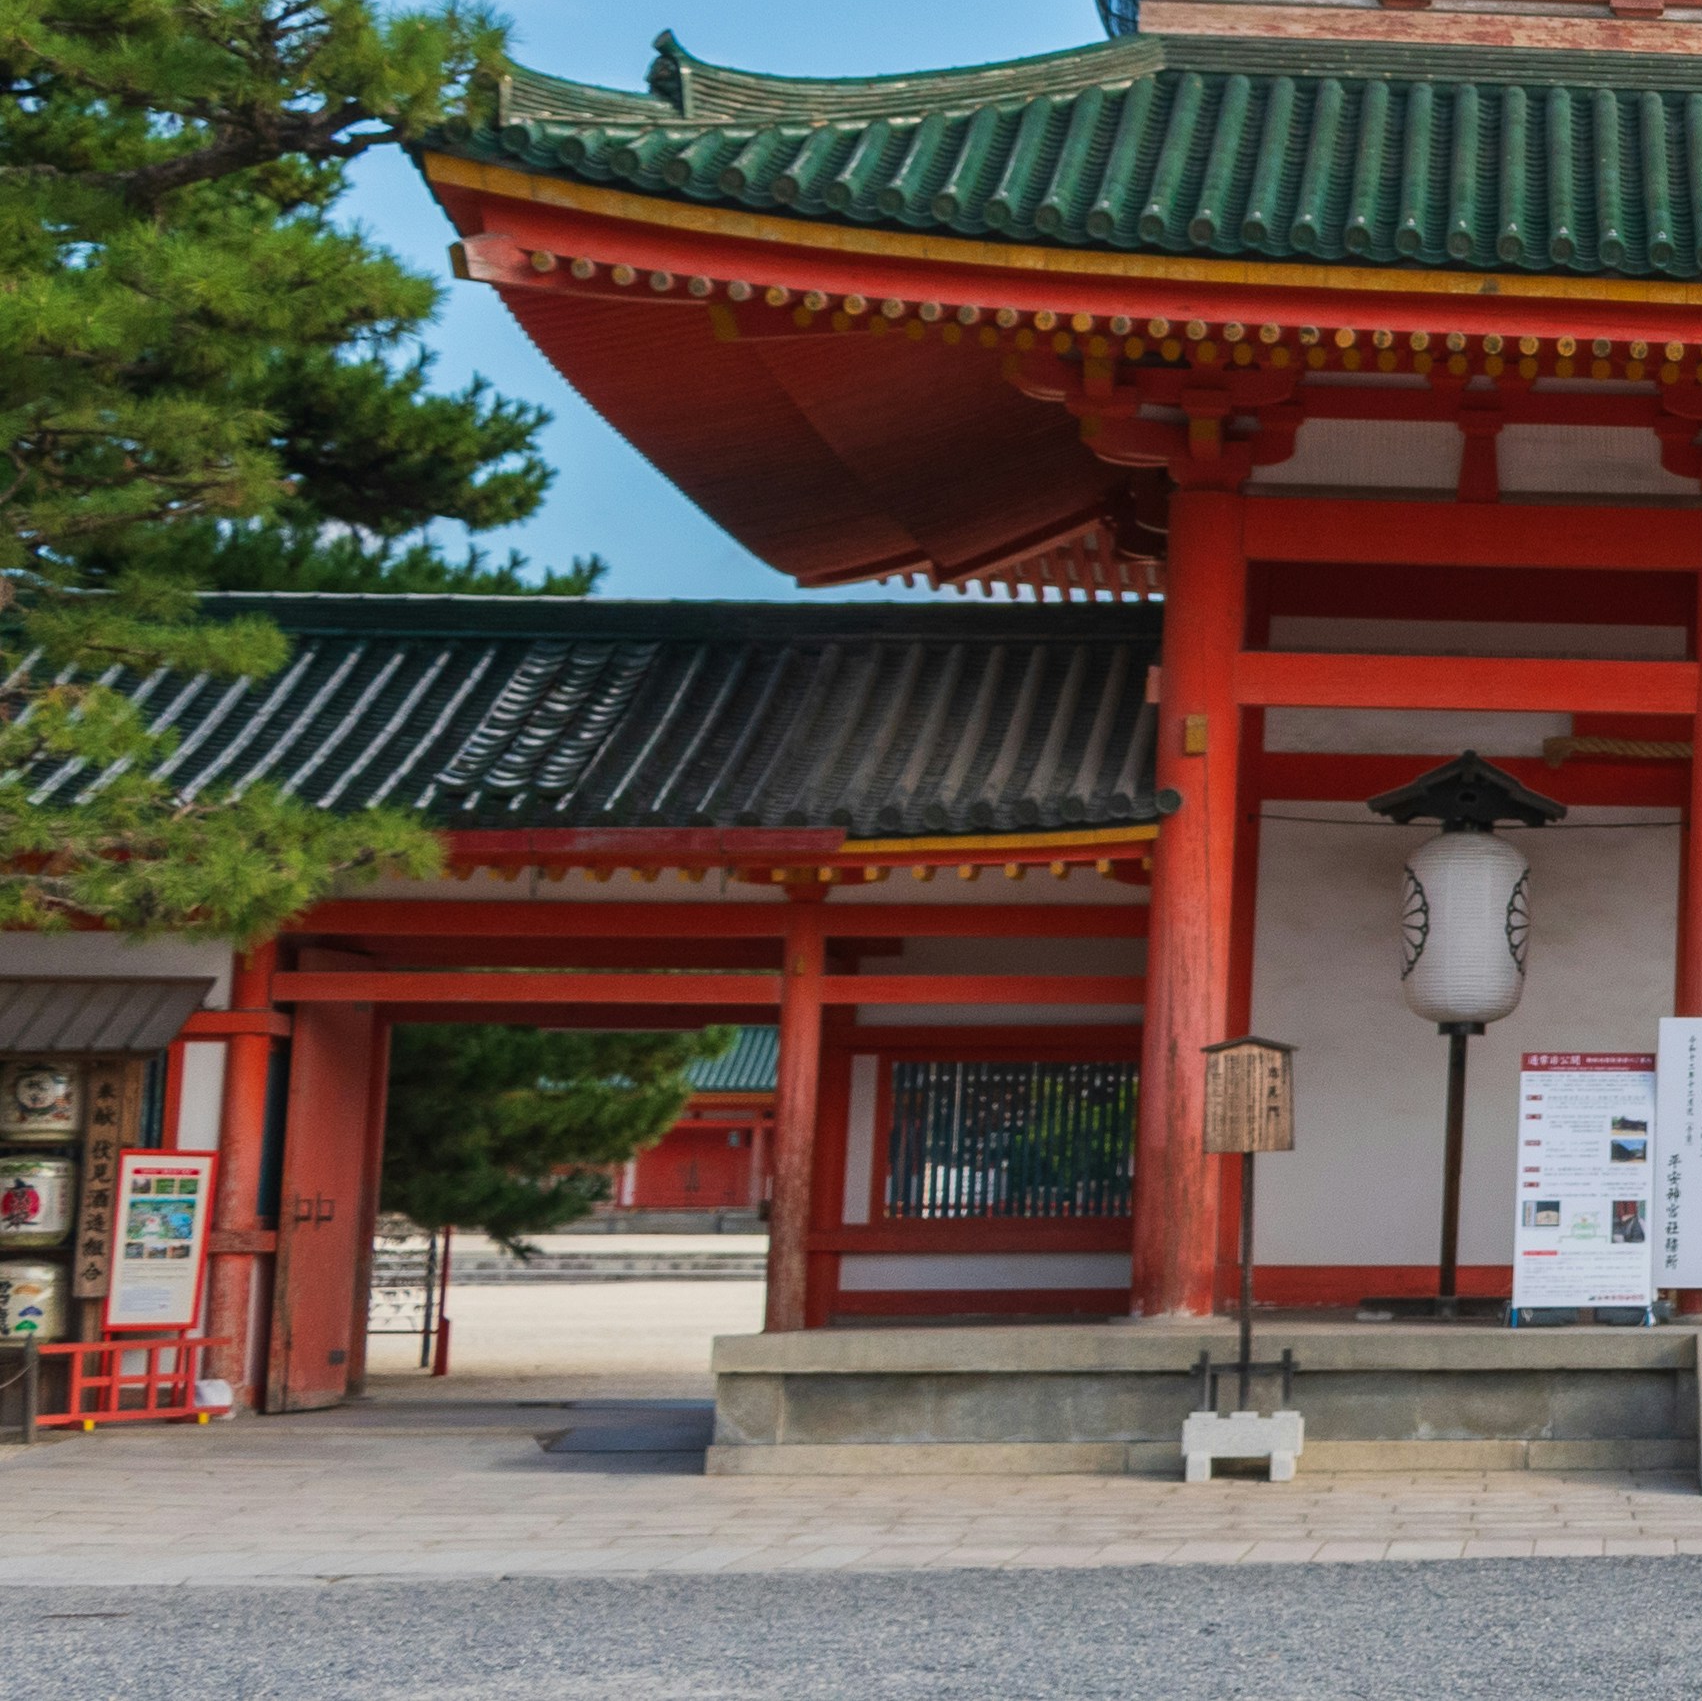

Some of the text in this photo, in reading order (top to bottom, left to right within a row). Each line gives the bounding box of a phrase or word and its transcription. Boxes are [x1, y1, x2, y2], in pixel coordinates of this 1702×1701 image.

[1665, 1153, 1682, 1270] 平安神宮社務所
